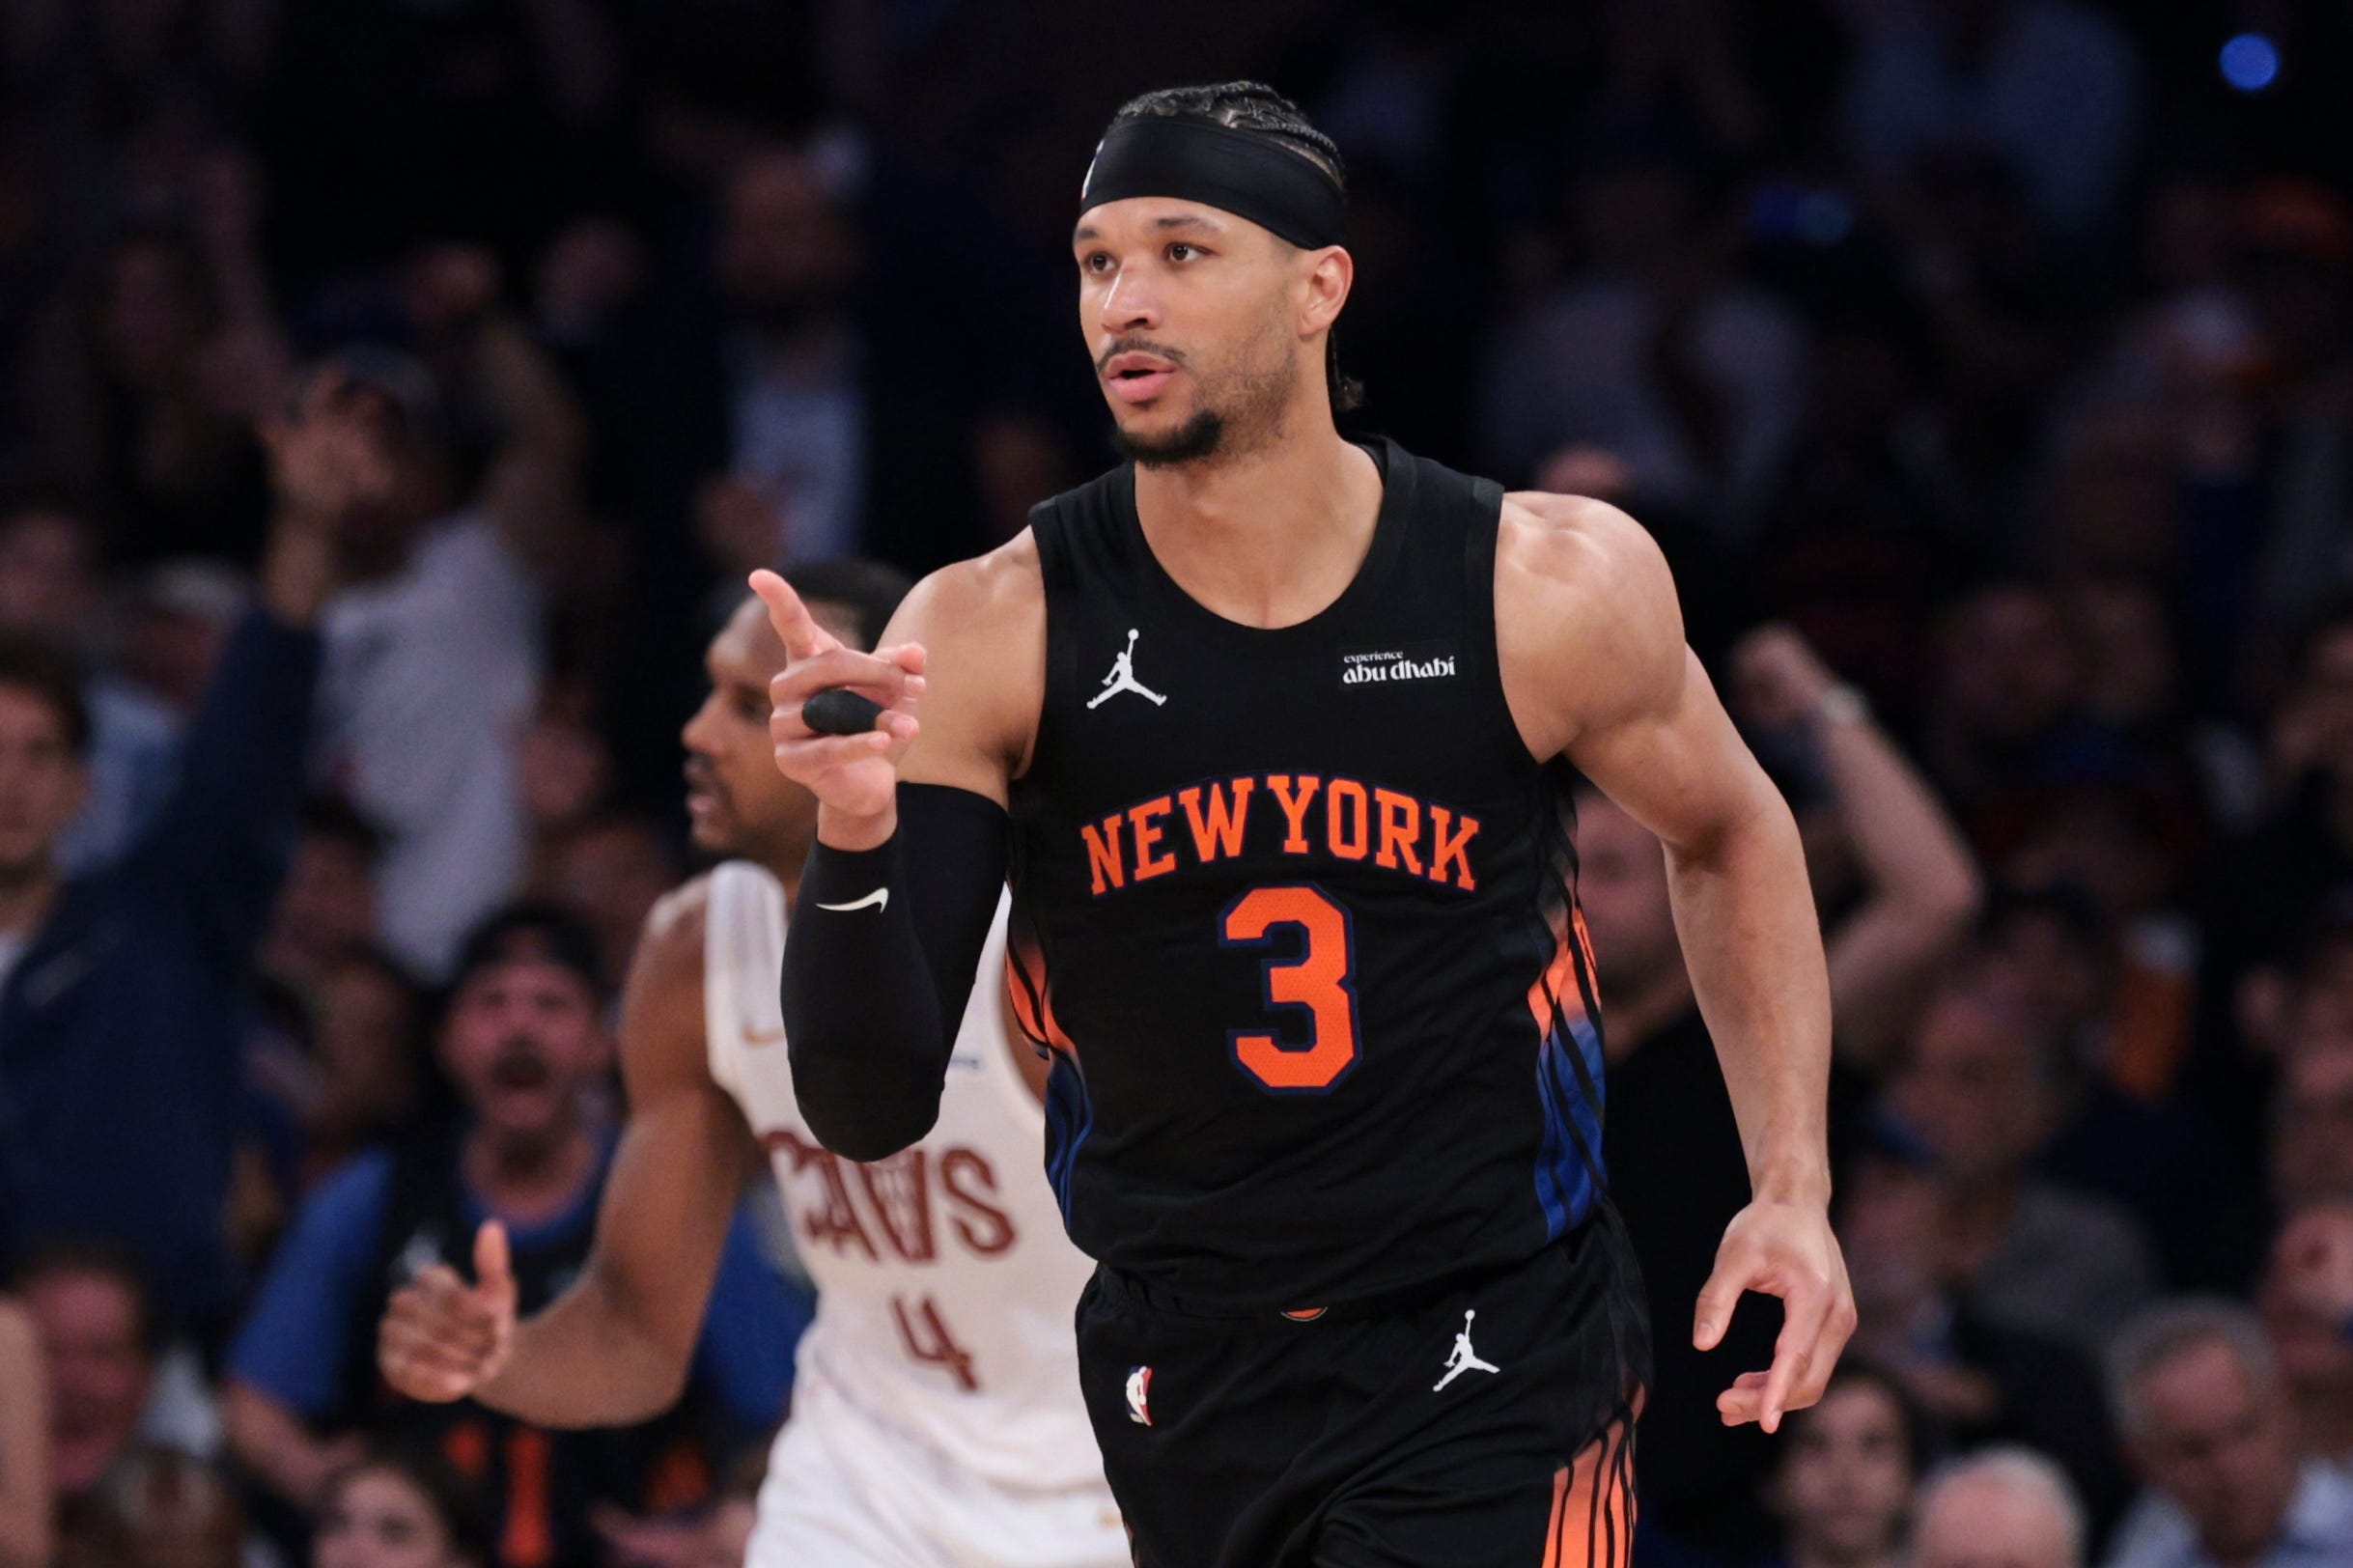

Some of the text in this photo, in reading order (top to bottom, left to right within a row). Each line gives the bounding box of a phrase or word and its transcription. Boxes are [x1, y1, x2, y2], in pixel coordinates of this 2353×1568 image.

[1342, 656, 1456, 684] abu dhabi
[1343, 651, 1404, 663] experience
[1079, 773, 1481, 897] NEW YORK
[1218, 882, 1362, 1095] 3
[890, 1294, 978, 1392] 4
